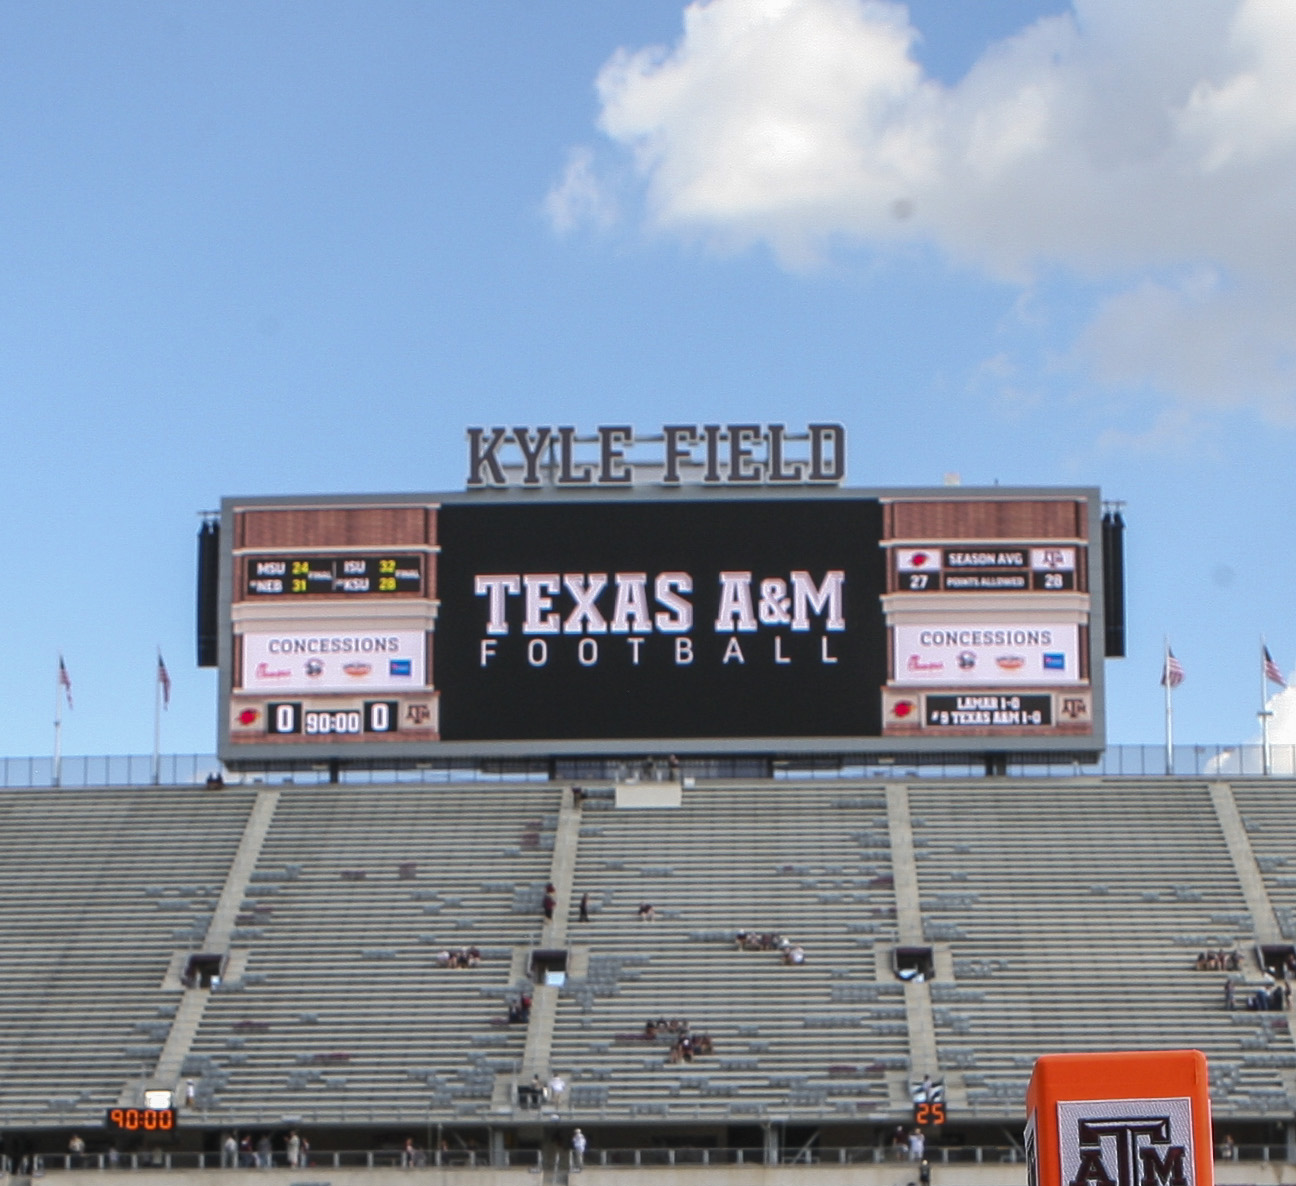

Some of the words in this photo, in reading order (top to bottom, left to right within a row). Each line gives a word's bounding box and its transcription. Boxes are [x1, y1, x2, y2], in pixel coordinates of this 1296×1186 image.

[466, 425, 633, 486] KYLE
[663, 423, 846, 484] FIELD
[910, 574, 929, 589] 27
[474, 572, 694, 634] TEXAS
[714, 570, 846, 632] A&M
[268, 637, 400, 654] CONCESSIONS
[920, 630, 1052, 646] CONCESSIONS
[480, 636, 838, 667] FOOTBALL
[276, 705, 294, 733] 0
[306, 712, 360, 733] 90:00
[371, 703, 389, 731] 0
[111, 1109, 173, 1130] 90:00
[916, 1103, 945, 1125] 25
